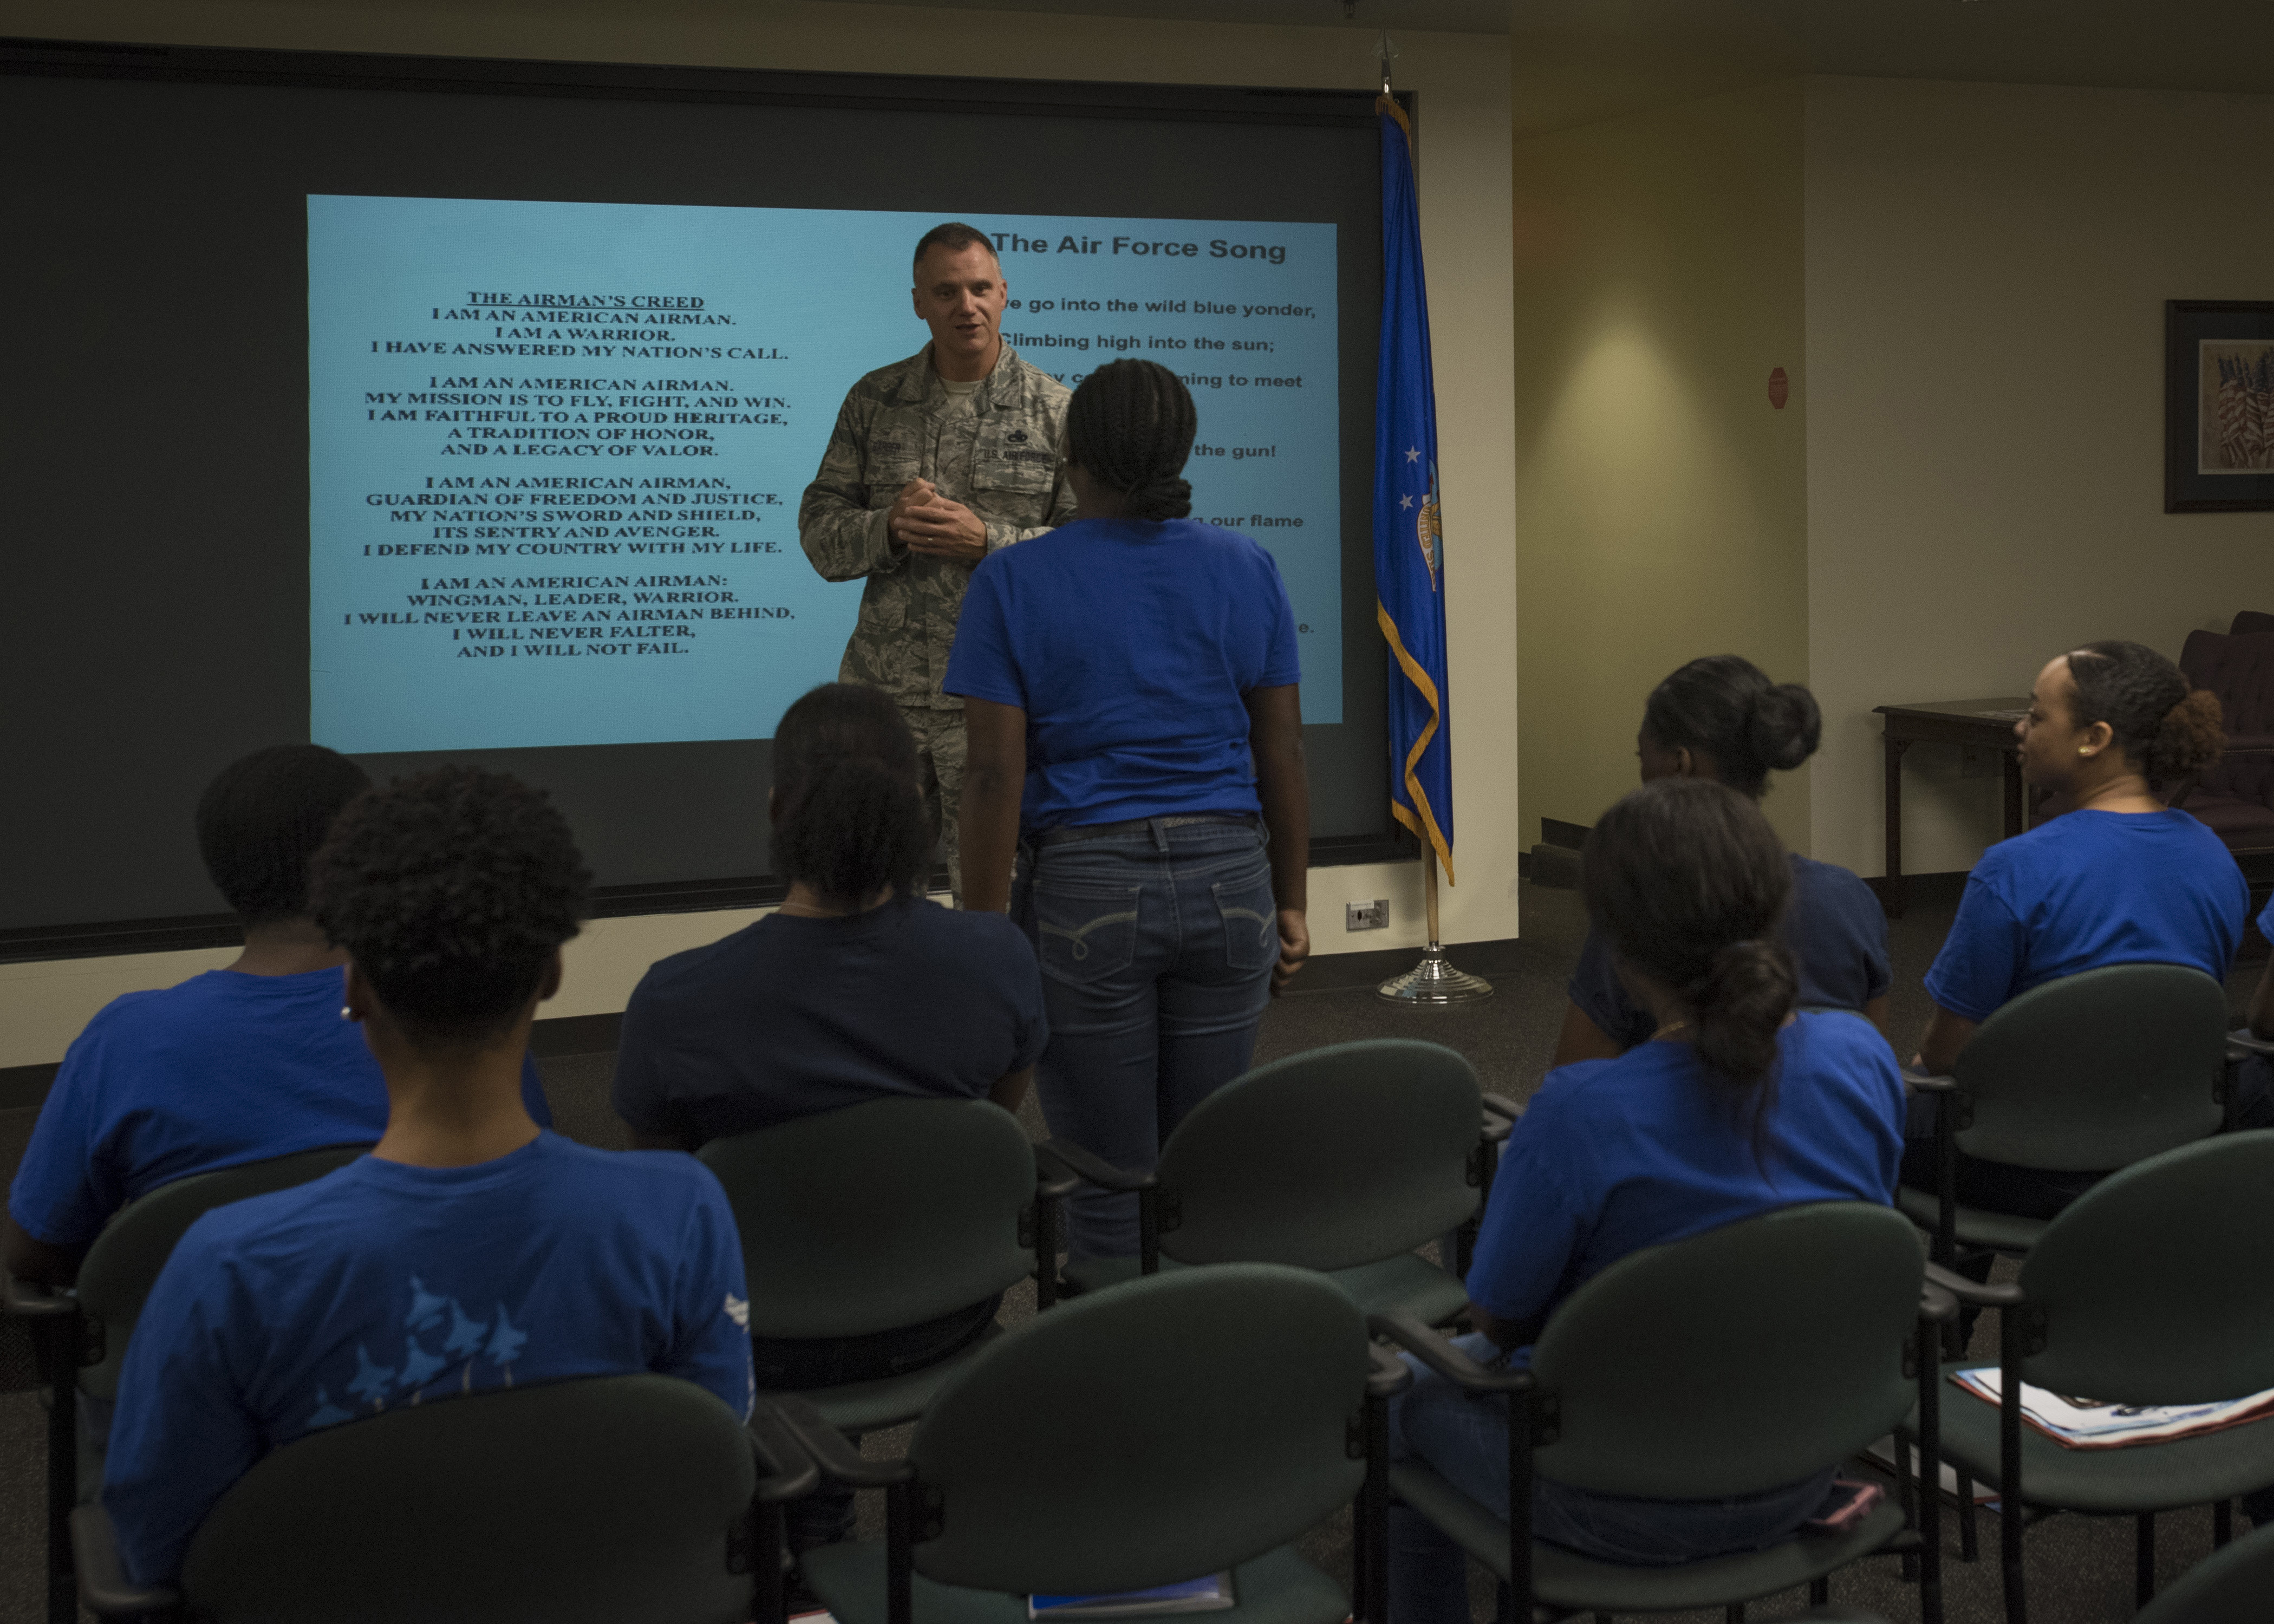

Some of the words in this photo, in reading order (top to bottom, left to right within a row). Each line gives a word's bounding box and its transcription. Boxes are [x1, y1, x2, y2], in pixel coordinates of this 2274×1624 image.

[991, 233, 1048, 253] The
[1057, 236, 1102, 255] Air
[1113, 236, 1198, 257] Force
[1209, 239, 1286, 265] Song
[469, 292, 511, 304] THE
[518, 295, 625, 306] AIRMAN'S
[631, 296, 704, 308] CREED
[1030, 300, 1054, 313] go
[1061, 298, 1100, 311] into
[1107, 299, 1138, 311] the
[1145, 300, 1185, 312] wild
[1194, 301, 1236, 314] blue
[1243, 304, 1315, 318] yonder,
[433, 309, 438, 319] I
[445, 309, 479, 321] AM
[486, 310, 515, 321] AN
[522, 311, 638, 324] AMERICAN
[645, 314, 735, 325] AIRMAN.
[496, 327, 502, 338] I
[508, 328, 541, 338] AM
[548, 330, 561, 339] A
[568, 329, 675, 341] WARRIOR.
[372, 342, 377, 353] I
[386, 342, 446, 354] HAVE
[452, 344, 576, 356] ANSWERED
[583, 345, 615, 356] MY
[623, 347, 721, 358] NATION'S
[727, 348, 787, 360] CALL.
[1098, 335, 1141, 351] high
[1149, 336, 1187, 349] into
[1194, 337, 1225, 349] the
[1232, 341, 1274, 353] sun;
[431, 377, 436, 388] I
[442, 377, 478, 388] AM
[484, 378, 513, 389] AN
[519, 379, 636, 390] AMERICAN
[642, 380, 733, 392] AIRMAN.
[1229, 374, 1248, 386] to
[1254, 376, 1302, 387] meet
[366, 393, 401, 403] MY
[408, 393, 502, 405] MISSION
[510, 395, 528, 406] IS
[534, 395, 564, 406] TO
[571, 396, 612, 408] FLY,
[620, 396, 689, 408] FIGHT,
[695, 397, 738, 408] AND
[745, 397, 790, 408] WIN.
[369, 410, 374, 420] I
[381, 410, 416, 421] AM
[426, 410, 535, 422] FAITHFUL
[539, 412, 569, 423] TO
[575, 413, 588, 423] A
[595, 412, 668, 423] PROUD
[674, 413, 787, 426] HERITAGE,
[448, 428, 461, 438] A
[467, 428, 589, 440] TRADITION
[597, 429, 626, 440] OF
[631, 429, 714, 441] HONOR,
[441, 444, 487, 455] AND
[494, 445, 507, 455] A
[513, 445, 603, 456] LEGACY
[608, 446, 636, 456] OF
[643, 445, 718, 456] VALOR.
[1195, 443, 1226, 456] the
[1232, 445, 1276, 460] gun!
[426, 478, 433, 488] I
[439, 477, 474, 488] AM
[481, 477, 510, 488] AN
[516, 478, 633, 489] AMERICAN
[640, 478, 731, 490] AIRMAN,
[367, 494, 487, 506] GUARDIAN
[495, 494, 523, 505] OF
[531, 494, 636, 505] FREEDOM
[642, 494, 686, 505] AND
[692, 494, 783, 505] JUSTICE,
[391, 511, 426, 522] MY
[434, 511, 537, 522] NATION'S
[543, 510, 622, 522] SWORD
[628, 510, 673, 521] AND
[678, 510, 760, 522] SHIELD,
[1210, 517, 1244, 526] our
[1250, 514, 1304, 527] flame
[434, 527, 467, 538] ITS
[474, 527, 560, 538] SENTRY
[565, 527, 609, 538] AND
[615, 527, 719, 538] AVENGER.
[1420, 506, 1432, 549] UNITED
[364, 545, 370, 556] I
[378, 544, 470, 556] DEFEND
[476, 544, 510, 555] MY
[516, 543, 621, 555] COUNTRY
[628, 543, 685, 553] WITH
[692, 543, 725, 553] MY
[731, 542, 781, 553] LIFE.
[422, 579, 429, 590] I
[434, 578, 469, 590] AM
[475, 578, 505, 589] AN
[511, 577, 628, 589] AMERICAN
[635, 575, 727, 587] AIRMAN:
[407, 595, 527, 606] WINGMAN,
[535, 593, 627, 606] LEADER,
[634, 592, 738, 604] WARRIOR.
[345, 615, 350, 624] I
[359, 613, 418, 624] WILL
[425, 612, 500, 624] NEVER
[507, 611, 576, 622] LEAVE
[582, 611, 610, 622] AN
[617, 609, 703, 621] AIRMAN
[711, 608, 794, 619] BEHIND,
[453, 629, 459, 640] I
[467, 629, 524, 640] WILL
[530, 627, 603, 640] NEVER
[610, 625, 695, 638] FALTER,
[458, 646, 504, 657] AND
[511, 645, 517, 656] I
[524, 645, 581, 656] WILL
[587, 644, 631, 655] NOT
[637, 643, 688, 654] FAIL.
